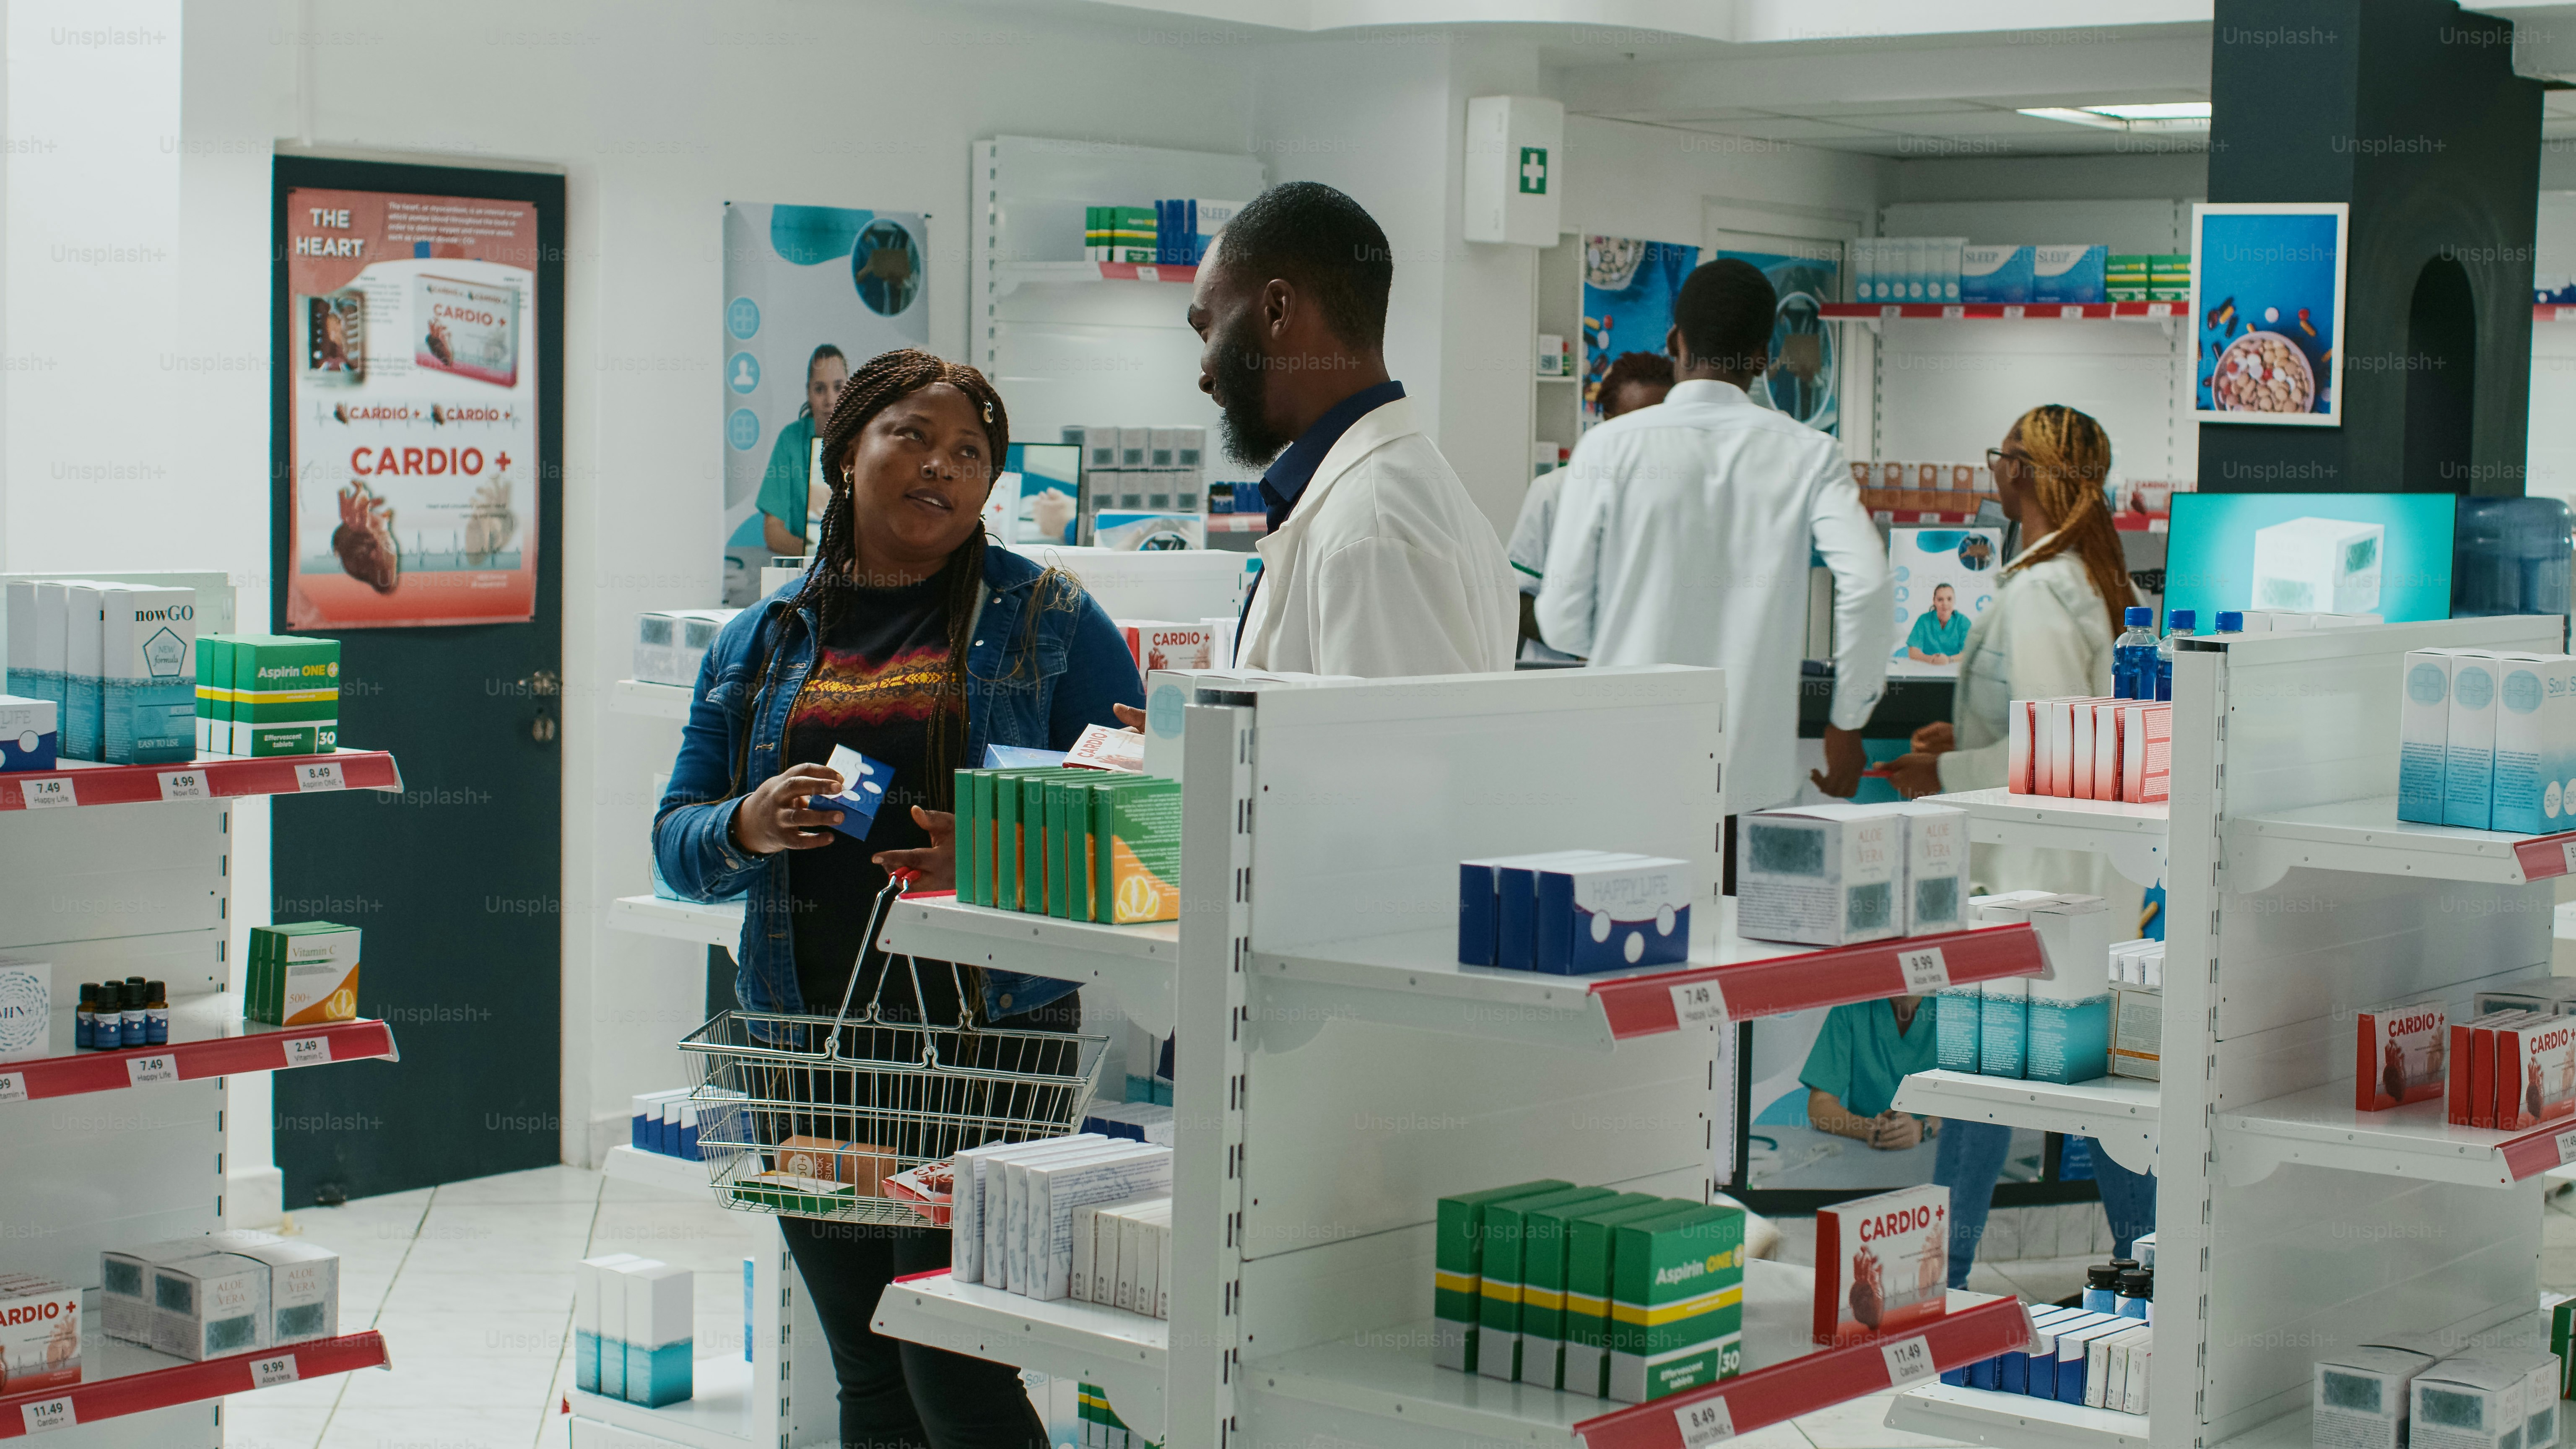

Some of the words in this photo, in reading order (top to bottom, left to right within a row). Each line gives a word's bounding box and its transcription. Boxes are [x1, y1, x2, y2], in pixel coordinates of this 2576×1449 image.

[310, 208, 350, 228] THE
[1200, 206, 1231, 220] SLEEP
[296, 236, 364, 257] HEART
[433, 303, 493, 326] CARDIO
[351, 407, 408, 420] CARDIO
[446, 408, 499, 421] CARDIO
[350, 447, 483, 475] CARDIO
[135, 605, 194, 622] nowGO
[1153, 631, 1200, 646] CARDIO
[158, 645, 175, 654] NEW
[153, 654, 179, 667] formula
[258, 666, 300, 679] Aspirin
[301, 665, 326, 676] ONE
[2548, 676, 2566, 693] Soul
[1, 710, 31, 724] LIFE
[138, 740, 155, 749] EASY
[156, 739, 165, 748] TO
[166, 738, 179, 747] USE
[264, 732, 302, 742] Effervescent
[273, 740, 294, 748] tablets
[318, 731, 335, 745] 30
[1077, 731, 1108, 758] CARDIO
[309, 768, 330, 778] 8.49
[36, 783, 60, 794] 7.49
[172, 776, 195, 787] 4.99
[302, 780, 323, 789] Aspirin
[34, 795, 55, 805] Happy
[56, 795, 69, 803] Life
[1858, 828, 1883, 843] ALOE
[1926, 823, 1950, 837] ALOE
[1857, 847, 1884, 864] VERA
[1925, 843, 1950, 858] VERA
[1591, 878, 1636, 901] HAPPY
[1640, 875, 1669, 896] LIFE
[293, 947, 327, 957] Vitamin
[330, 945, 337, 955] C
[1912, 956, 1933, 971] 9.99
[289, 994, 312, 1004] 500+
[1685, 987, 1710, 1005] 7.49
[2389, 1013, 2435, 1037] CARDIO
[295, 1041, 317, 1052] 2.49
[2530, 1028, 2569, 1054] CARDIO
[294, 1053, 317, 1062] Vitamin
[140, 1059, 163, 1071] 7.49
[137, 1072, 158, 1081] Happy
[159, 1071, 171, 1080] Life
[1860, 1205, 1929, 1242] CARDIO
[288, 1267, 315, 1279] ALOE
[1655, 1259, 1704, 1285] Aspirin
[1706, 1250, 1733, 1273] ONE
[217, 1279, 244, 1292] ALOE
[289, 1281, 316, 1293] VERA
[218, 1294, 245, 1306] VERA
[1894, 1343, 1921, 1364] 11.49
[262, 1361, 284, 1373] 9.99
[1721, 1350, 1740, 1374] 30
[262, 1375, 276, 1383] Aloe
[2534, 1370, 2550, 1384] ALOE
[2534, 1385, 2550, 1398] VERA
[34, 1402, 63, 1417] 11.49
[37, 1417, 59, 1427] Cardio
[1690, 1407, 1715, 1428] 8.49
